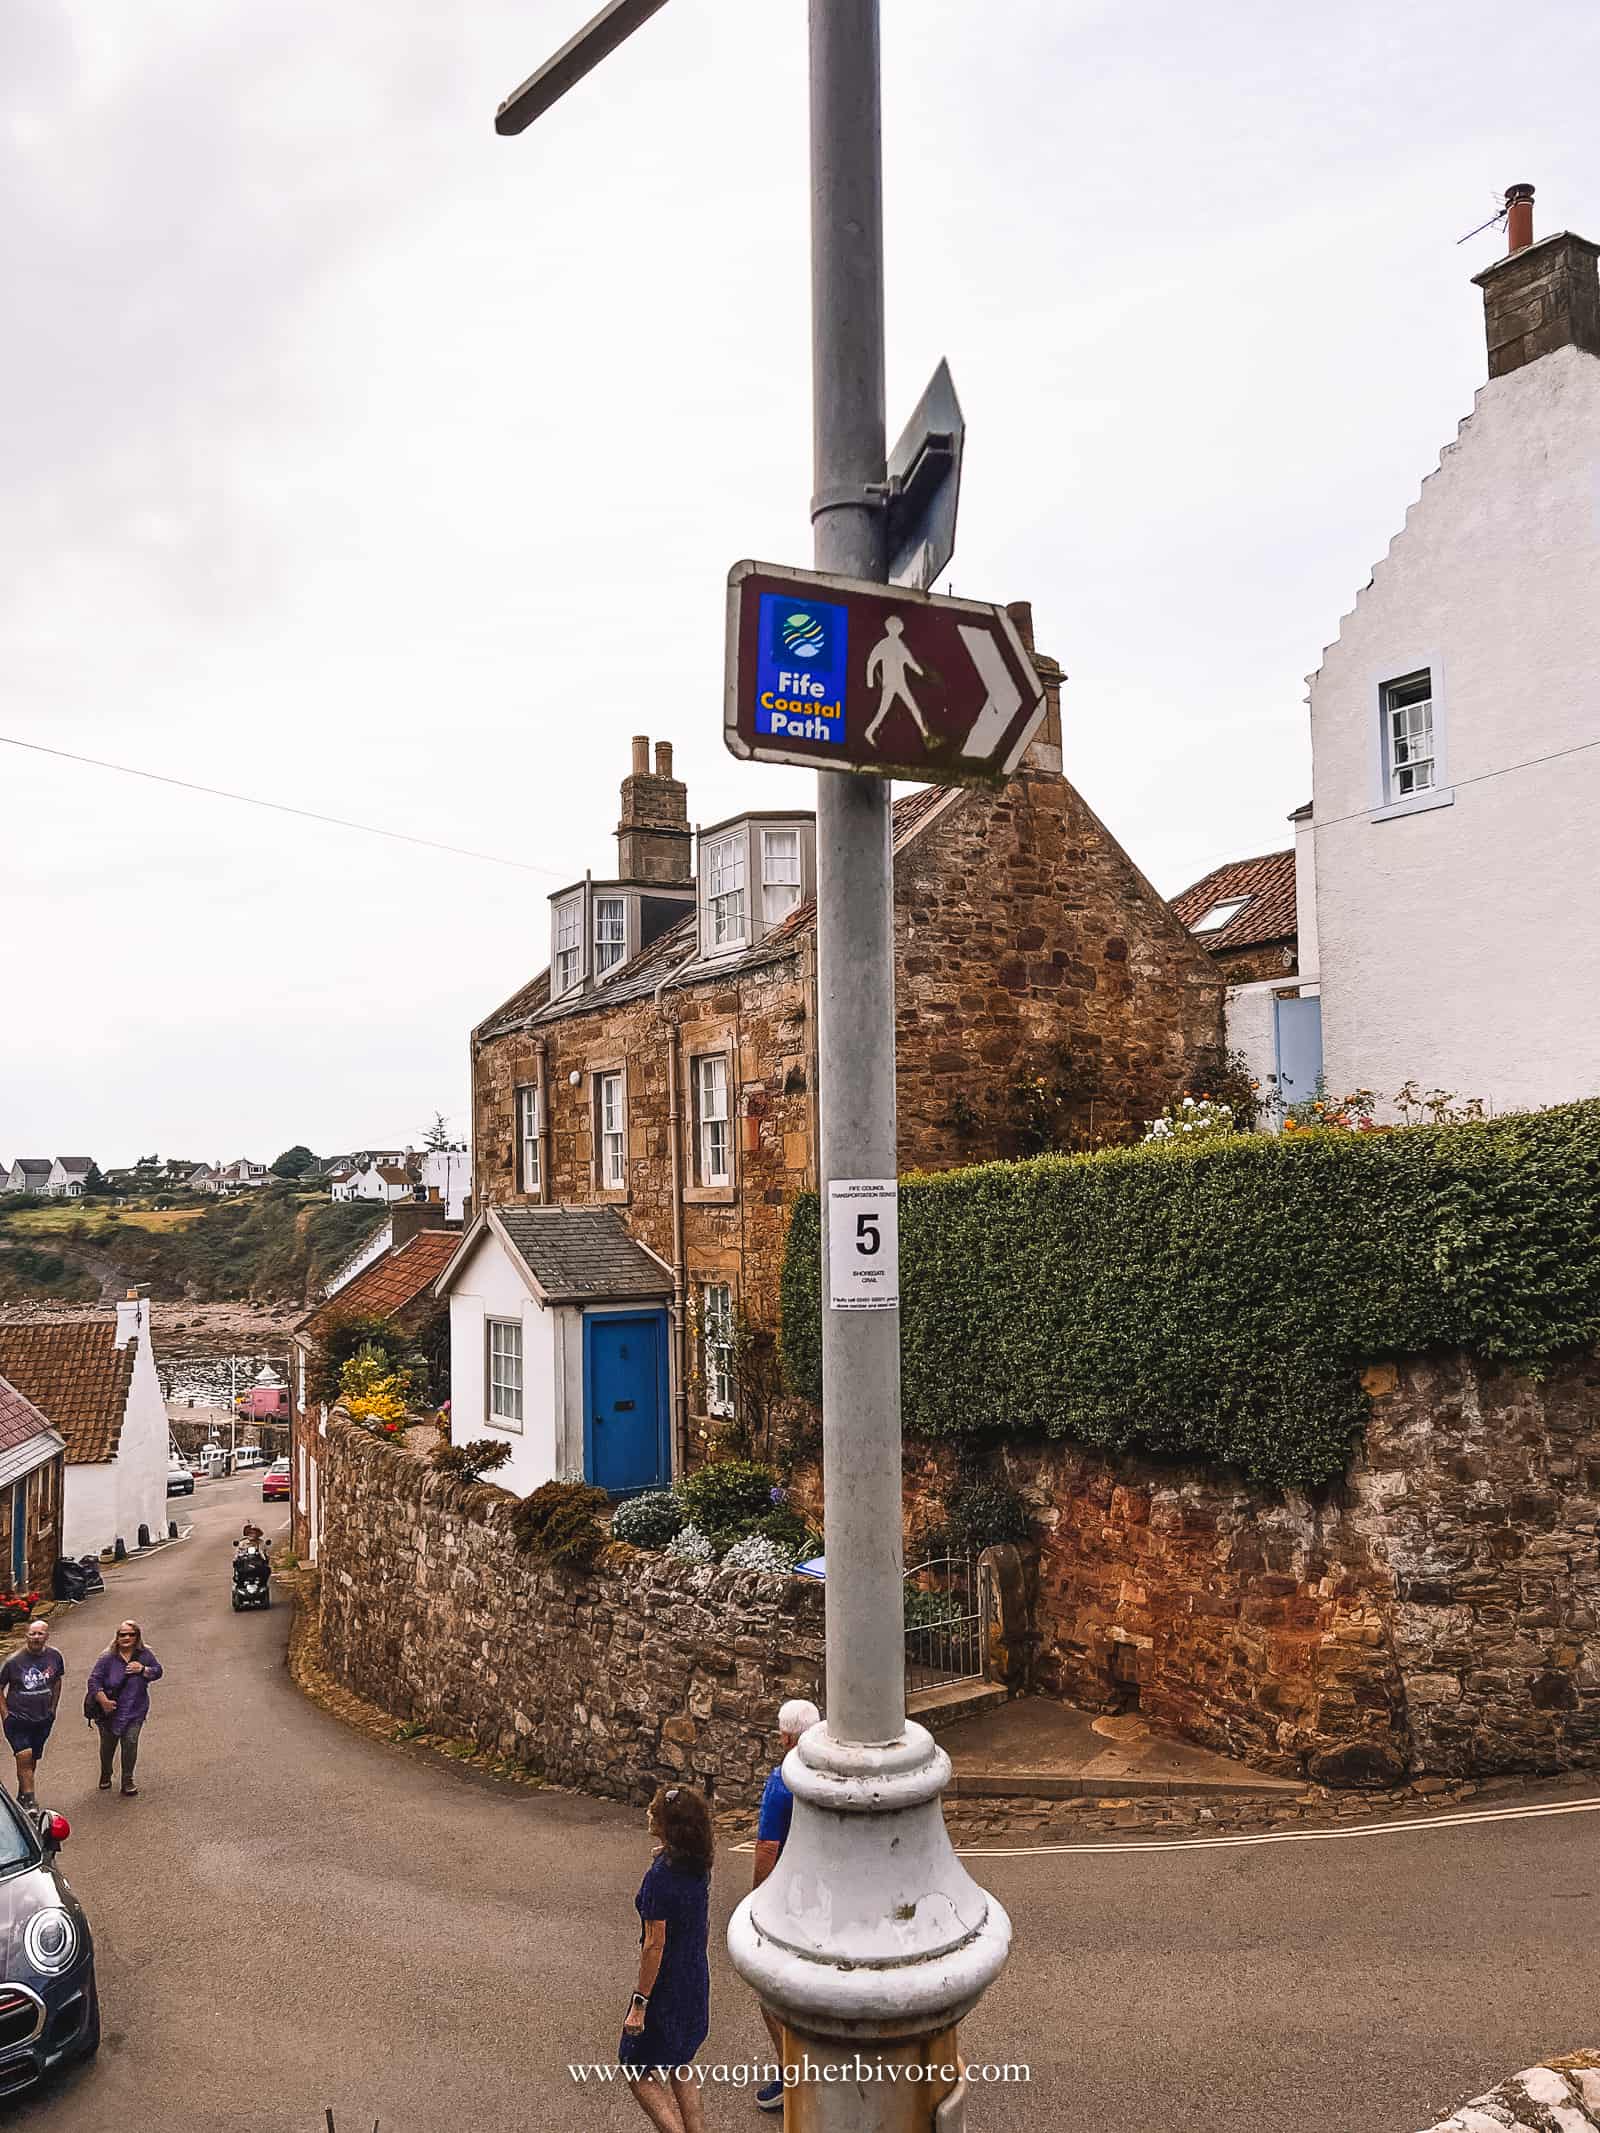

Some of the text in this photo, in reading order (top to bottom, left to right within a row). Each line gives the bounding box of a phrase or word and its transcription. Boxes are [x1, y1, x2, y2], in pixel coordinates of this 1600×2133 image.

[778, 671, 825, 698] Fife
[760, 691, 841, 720] Coastal
[770, 712, 830, 741] Path
[855, 1213, 881, 1256] 5
